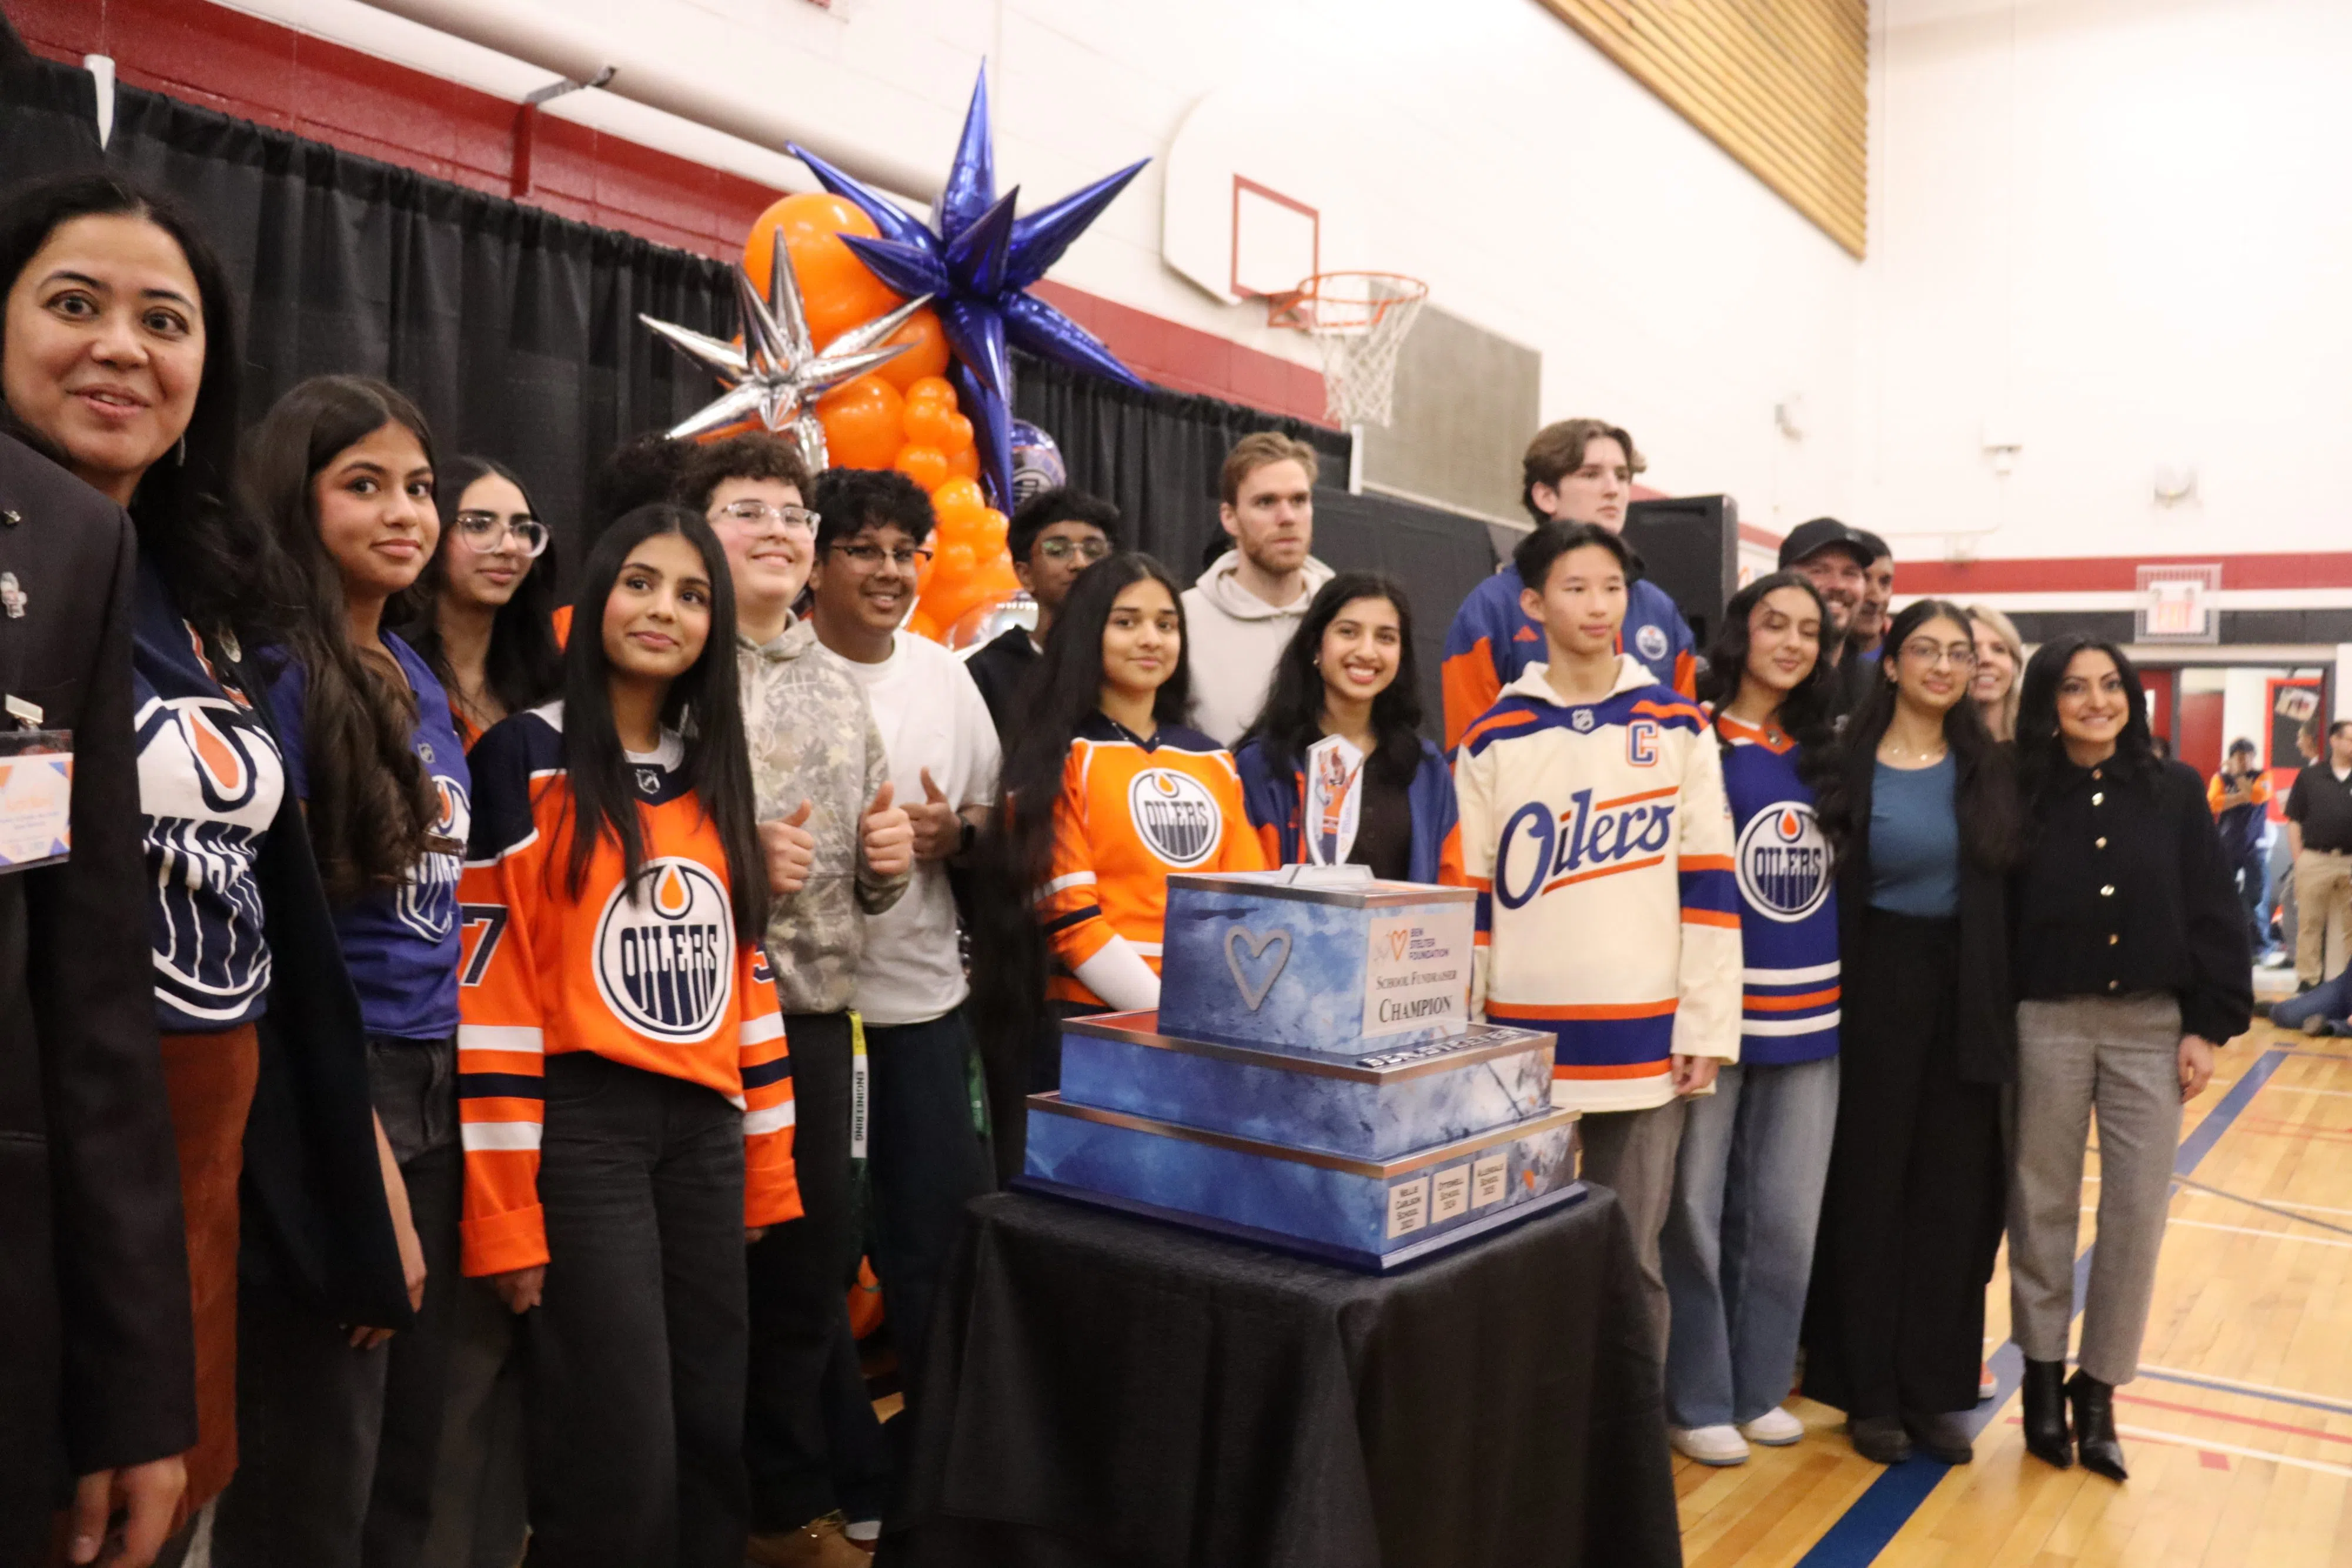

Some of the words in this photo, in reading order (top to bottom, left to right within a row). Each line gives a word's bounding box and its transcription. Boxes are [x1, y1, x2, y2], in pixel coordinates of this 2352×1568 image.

[1626, 719, 1659, 767] C
[1144, 801, 1209, 841] OILERS
[1496, 787, 1676, 910] Oilers
[1755, 847, 1822, 891] OILERS
[621, 924, 718, 999] OILERS
[854, 1071, 864, 1141] ENGINEERING
